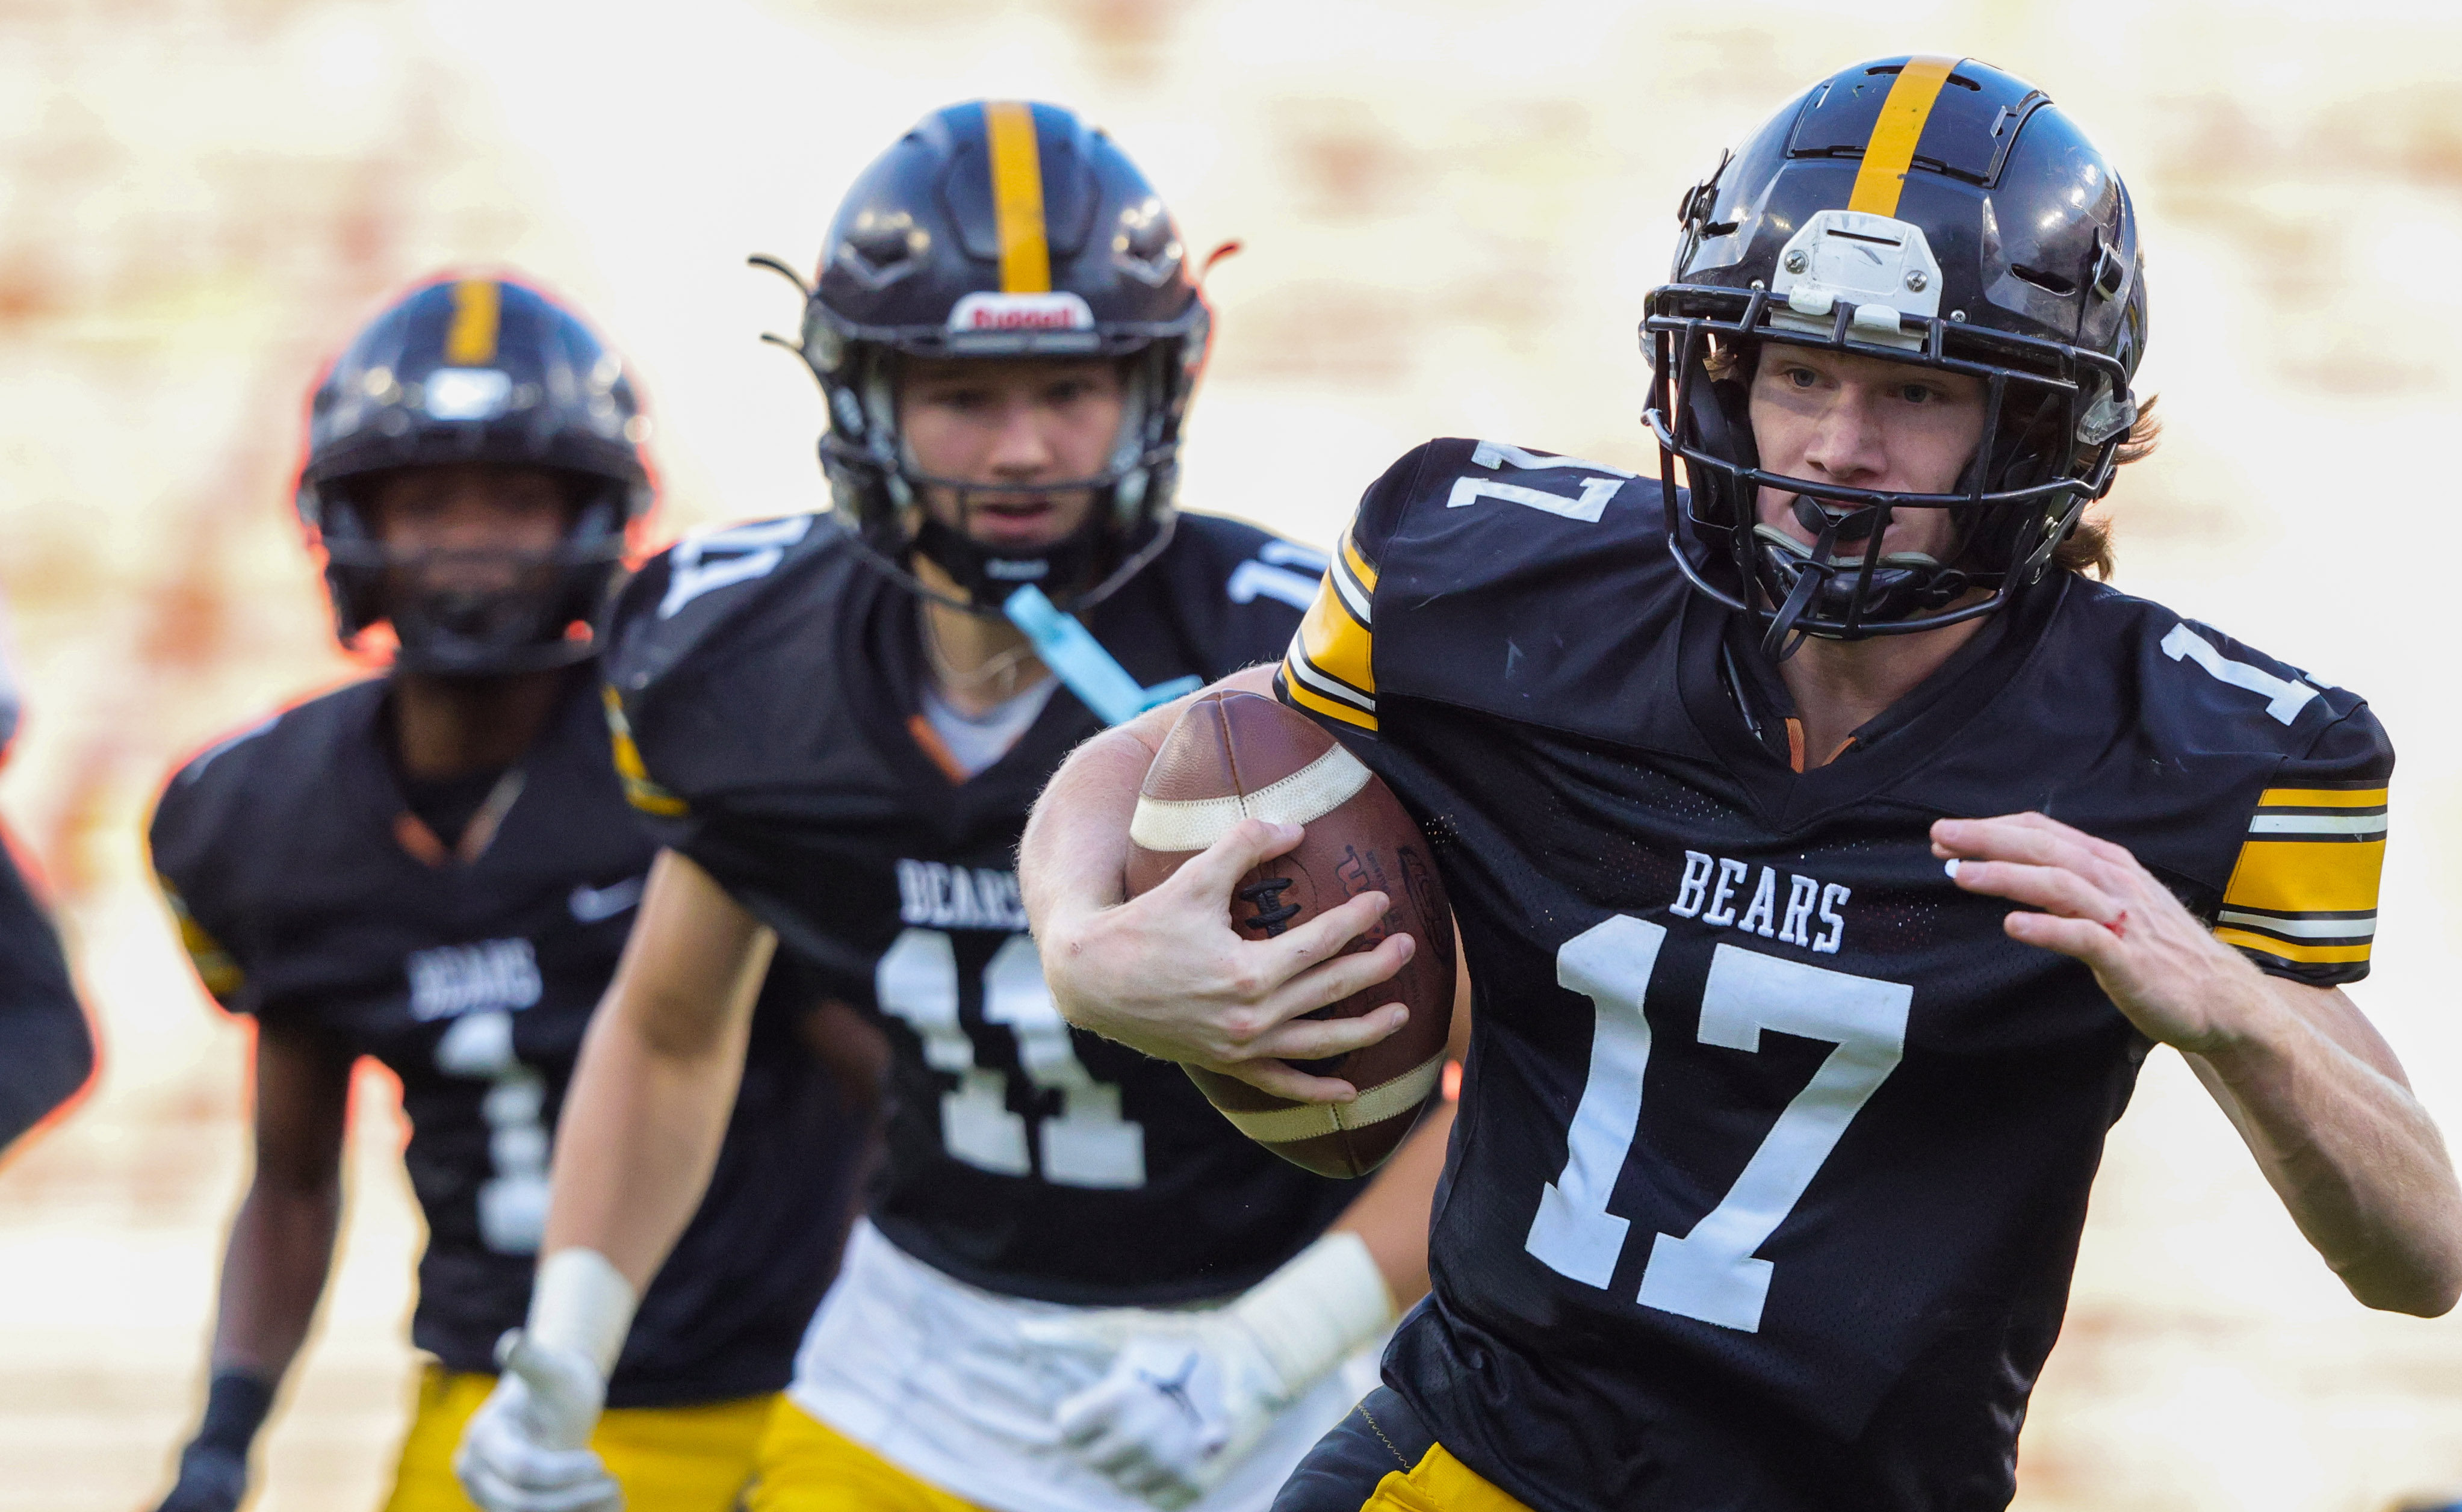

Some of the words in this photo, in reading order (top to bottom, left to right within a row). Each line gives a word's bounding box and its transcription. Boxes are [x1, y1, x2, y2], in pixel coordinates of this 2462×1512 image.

[1669, 850, 1851, 954] BEARS
[875, 927, 1147, 1191] 11
[1525, 914, 1914, 1333] 17
